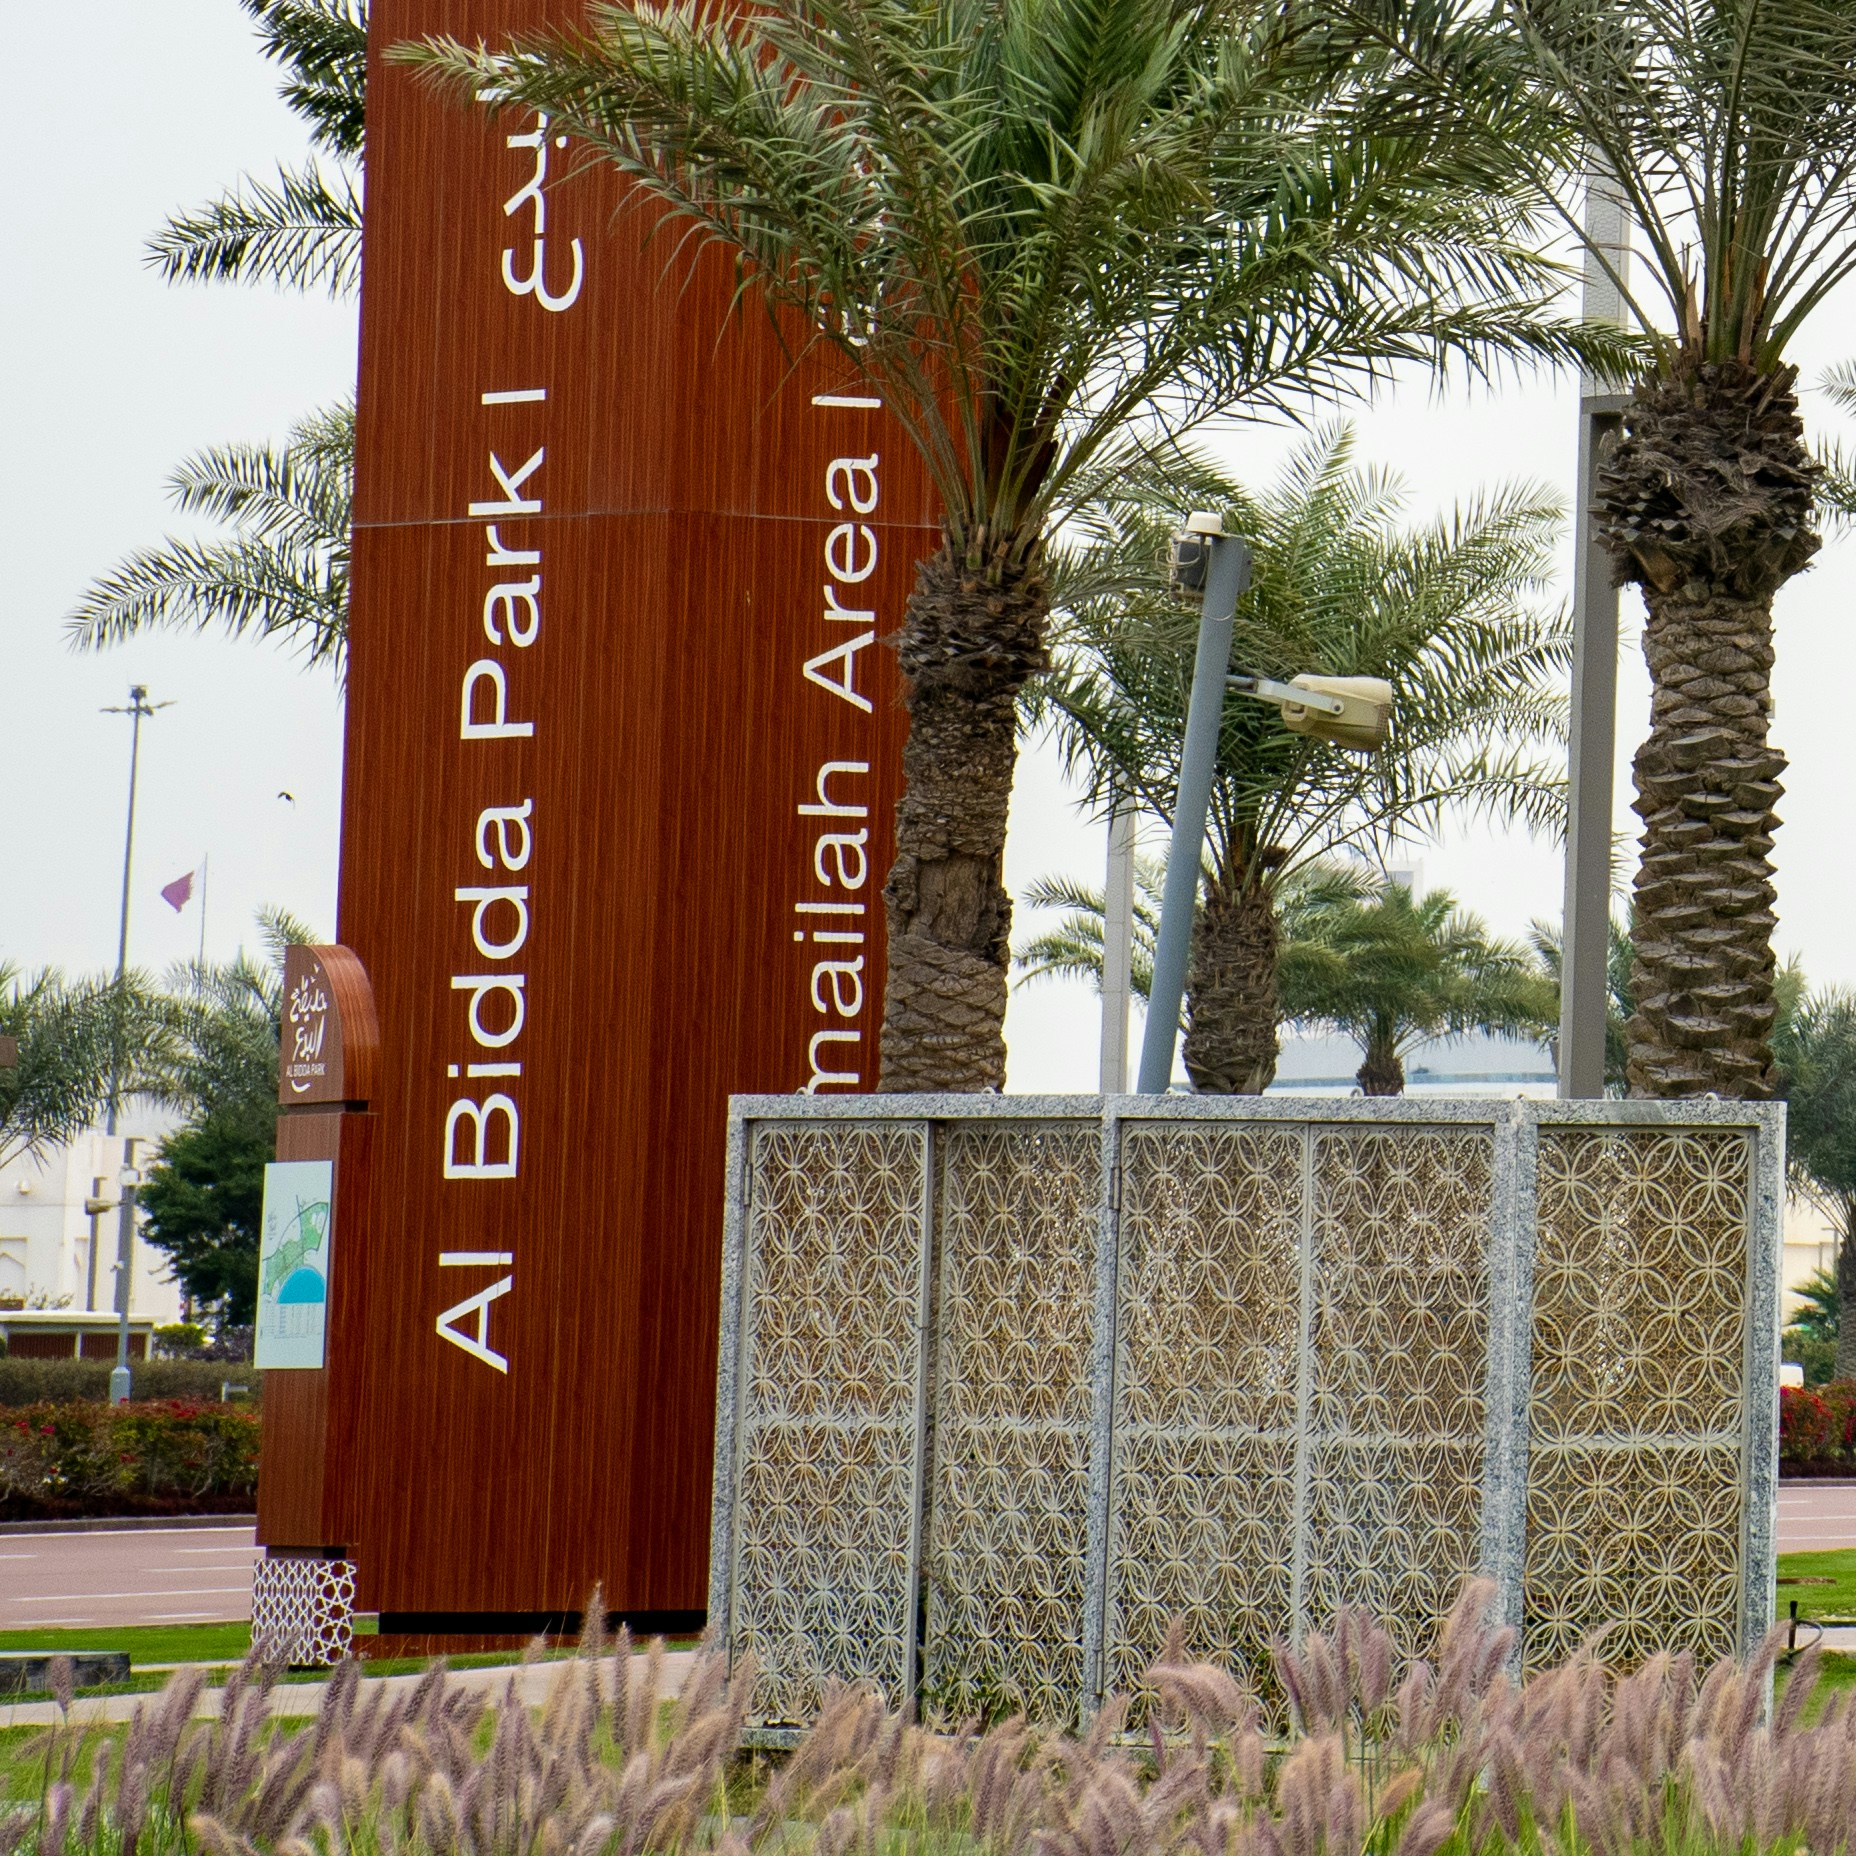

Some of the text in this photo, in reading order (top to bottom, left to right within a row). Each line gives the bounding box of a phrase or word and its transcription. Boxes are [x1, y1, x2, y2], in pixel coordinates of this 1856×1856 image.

[437, 446, 545, 1373] Al Bidda Park
[793, 452, 880, 1093] mailah Area
